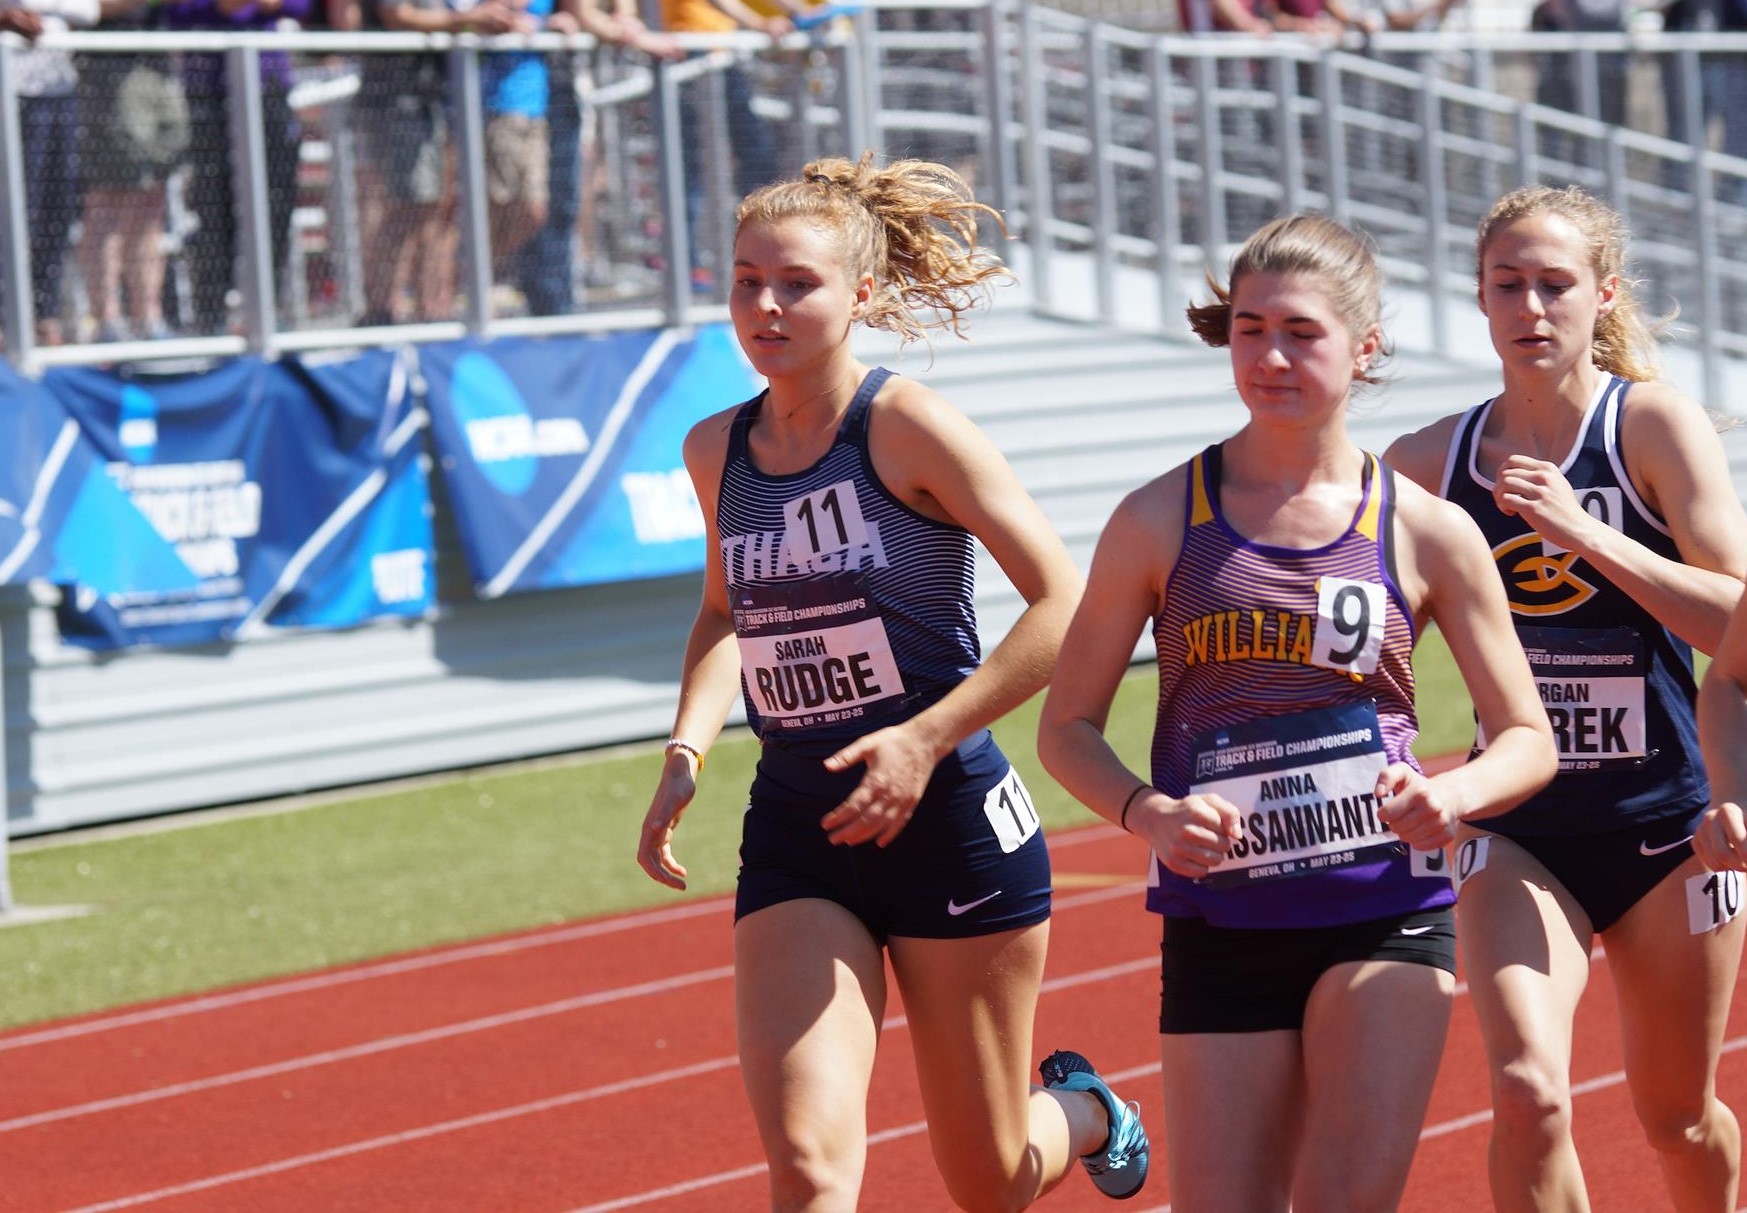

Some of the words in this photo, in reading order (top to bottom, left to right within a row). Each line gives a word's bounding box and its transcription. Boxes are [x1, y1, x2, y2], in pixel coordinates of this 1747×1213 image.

[798, 488, 849, 553] 11
[745, 612, 768, 625] TRACK
[774, 609, 793, 622] FIELD
[794, 598, 866, 620] CHAMPIONSHIPS
[1328, 585, 1370, 665] 9
[775, 635, 827, 661] SARAH
[1182, 609, 1364, 683] WILLIA
[1528, 653, 1551, 664] FIELD
[1552, 654, 1635, 666] CHAMPIONSHIPS
[756, 651, 882, 712] RUDGE
[1537, 683, 1590, 703] RGAN
[825, 712, 840, 722] MAY
[1215, 752, 1246, 768] TRACK
[1256, 747, 1283, 761] FIELD
[1286, 728, 1372, 755] CHAMPIONSHIPS
[999, 773, 1036, 837] 11
[1260, 773, 1318, 802] ANNA
[1222, 792, 1391, 860] SSANNANT
[1310, 857, 1330, 868] MAY
[1702, 869, 1738, 925] 10
